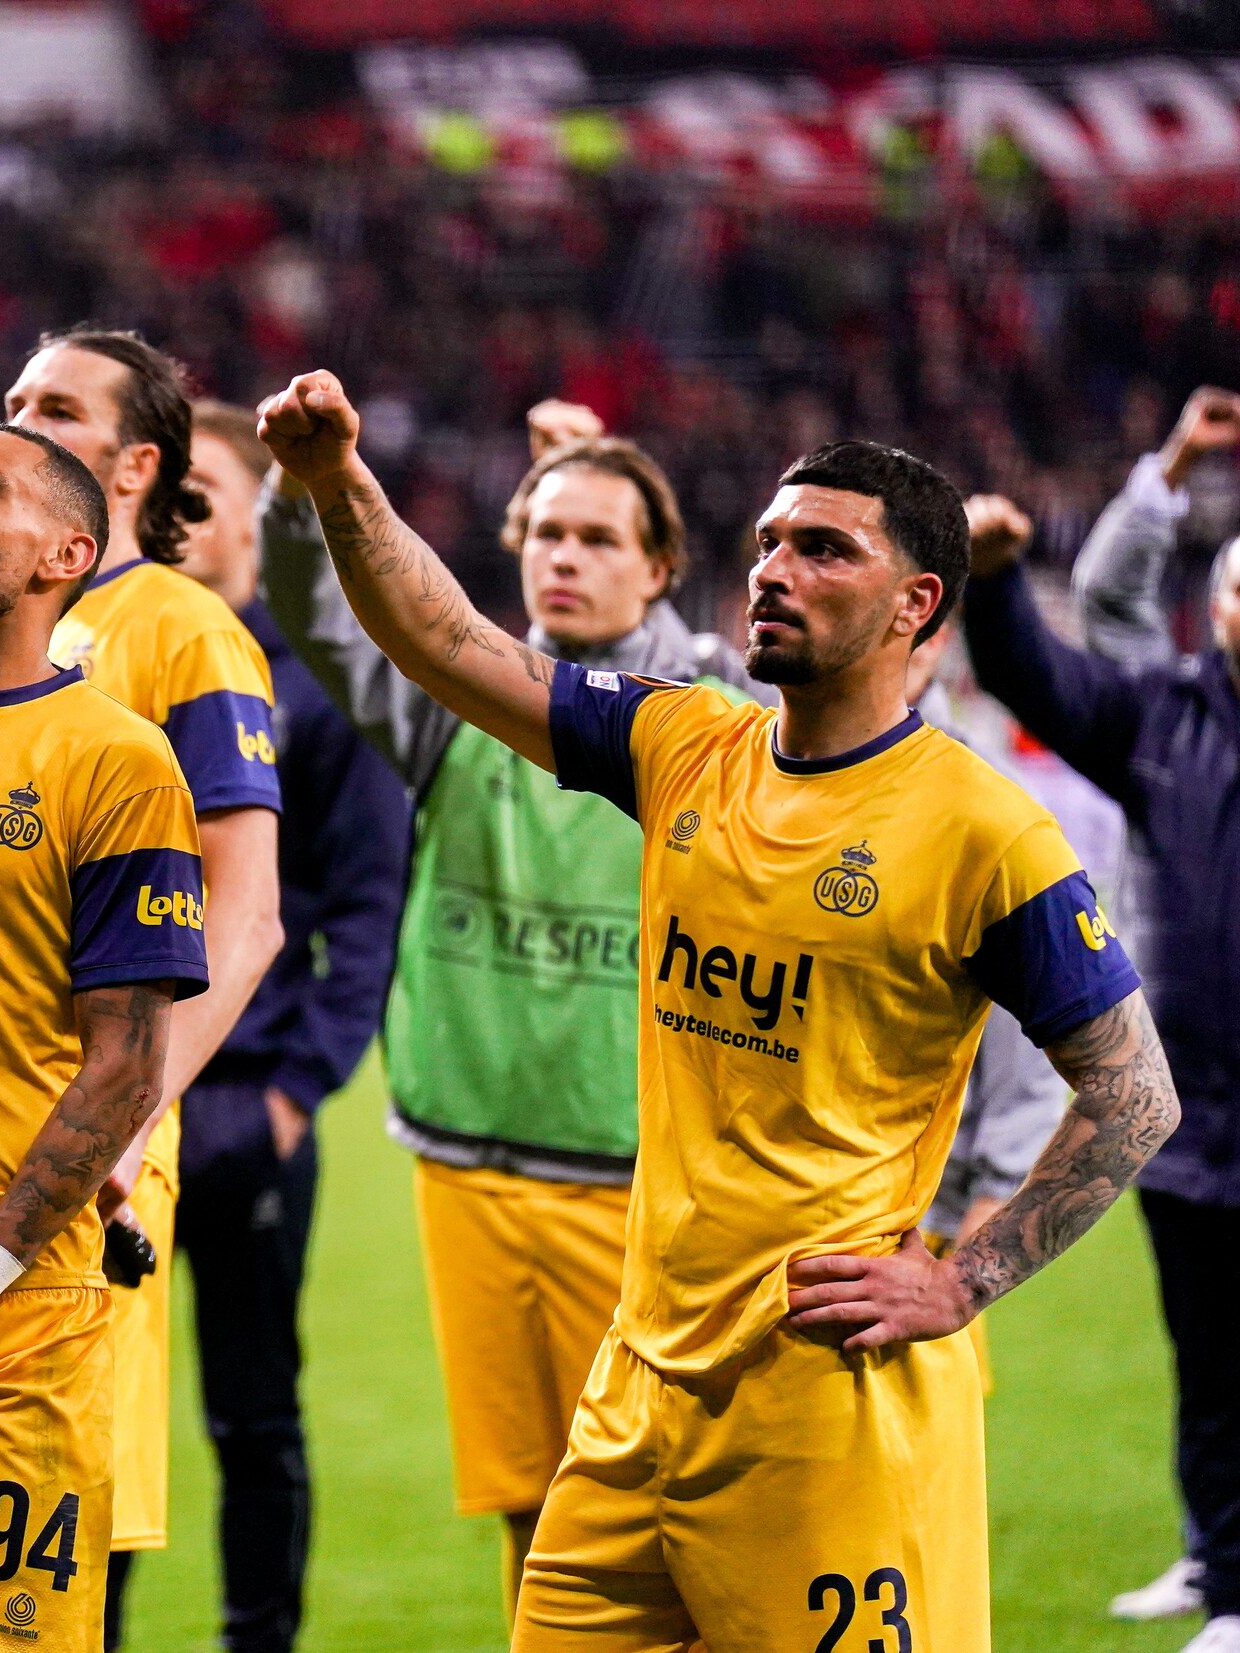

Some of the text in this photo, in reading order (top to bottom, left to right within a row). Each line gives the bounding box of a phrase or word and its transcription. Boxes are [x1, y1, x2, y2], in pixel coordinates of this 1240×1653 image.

[820, 876, 872, 908] USG
[658, 916, 813, 1031] hey!
[655, 1003, 799, 1063] heytelecom.be
[808, 1567, 913, 1653] 23
